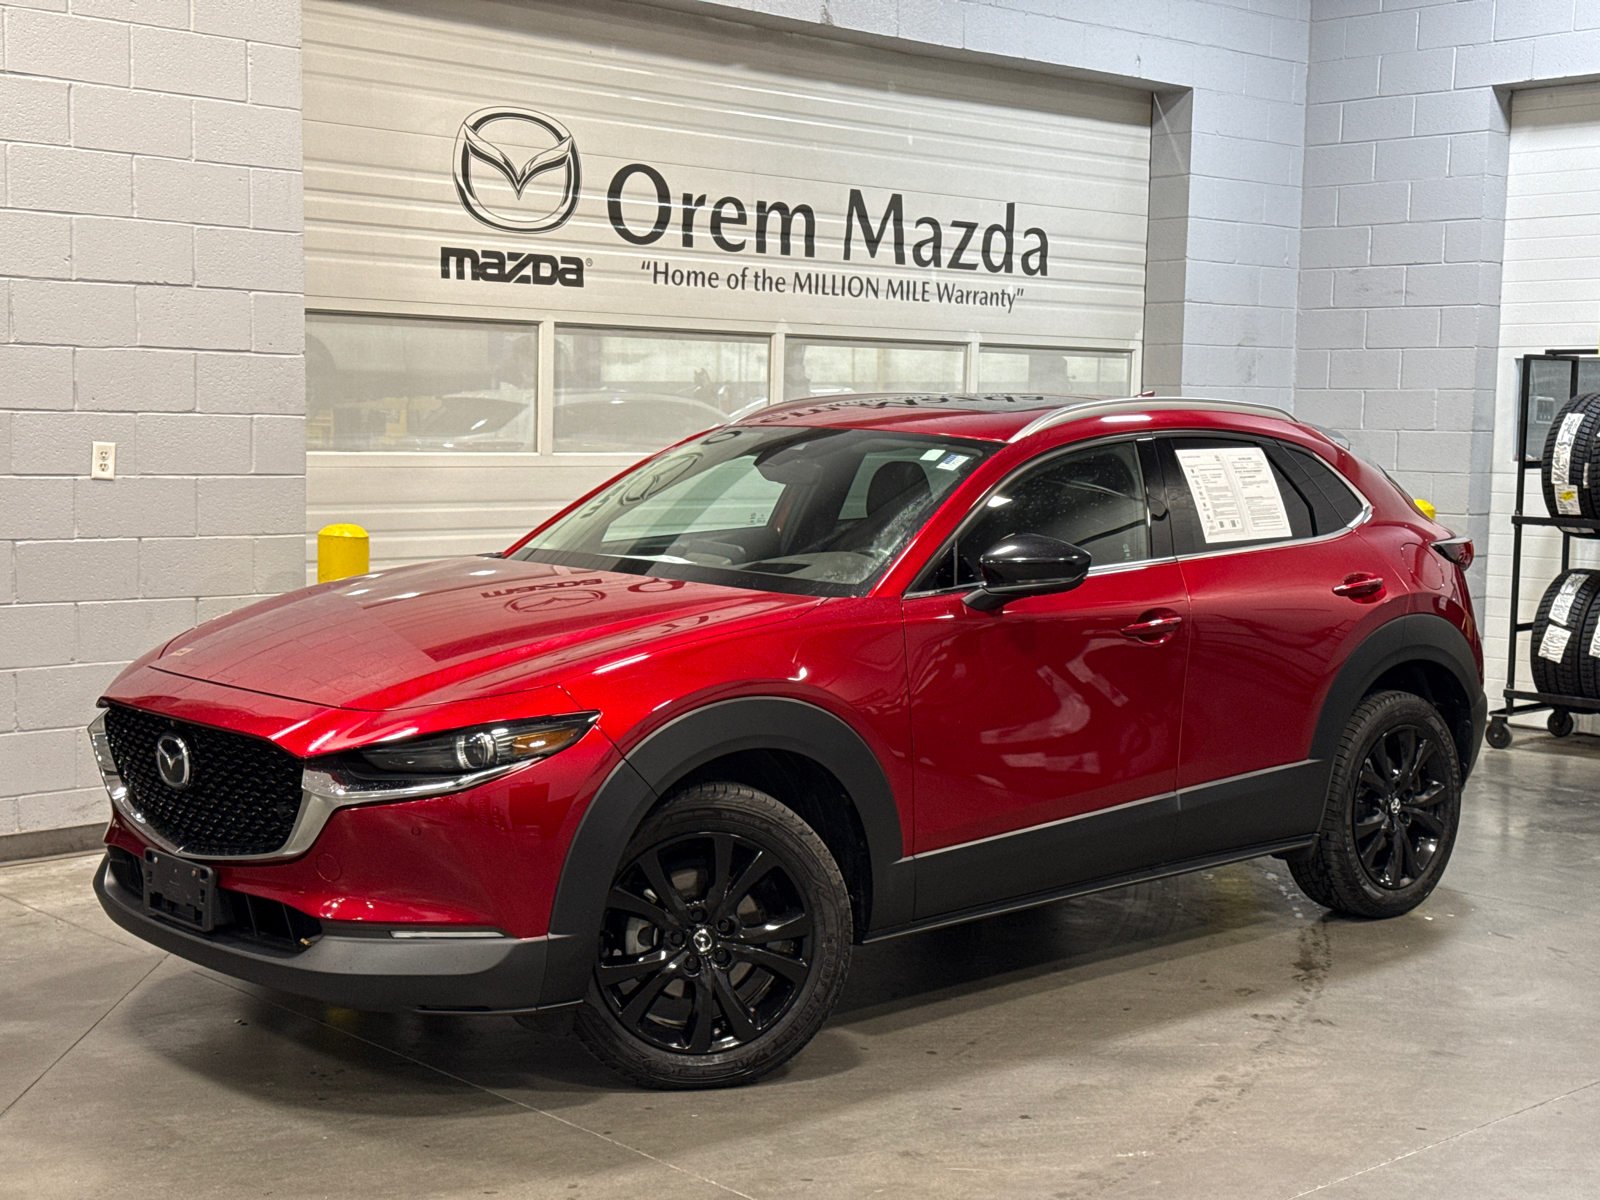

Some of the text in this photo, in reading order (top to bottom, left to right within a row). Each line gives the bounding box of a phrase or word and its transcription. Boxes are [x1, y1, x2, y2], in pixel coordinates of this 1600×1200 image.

[607, 163, 1049, 277] Orem Mazda
[440, 246, 585, 288] mazda
[641, 260, 1025, 314] "Home of the MILLION MILE Warranty"
